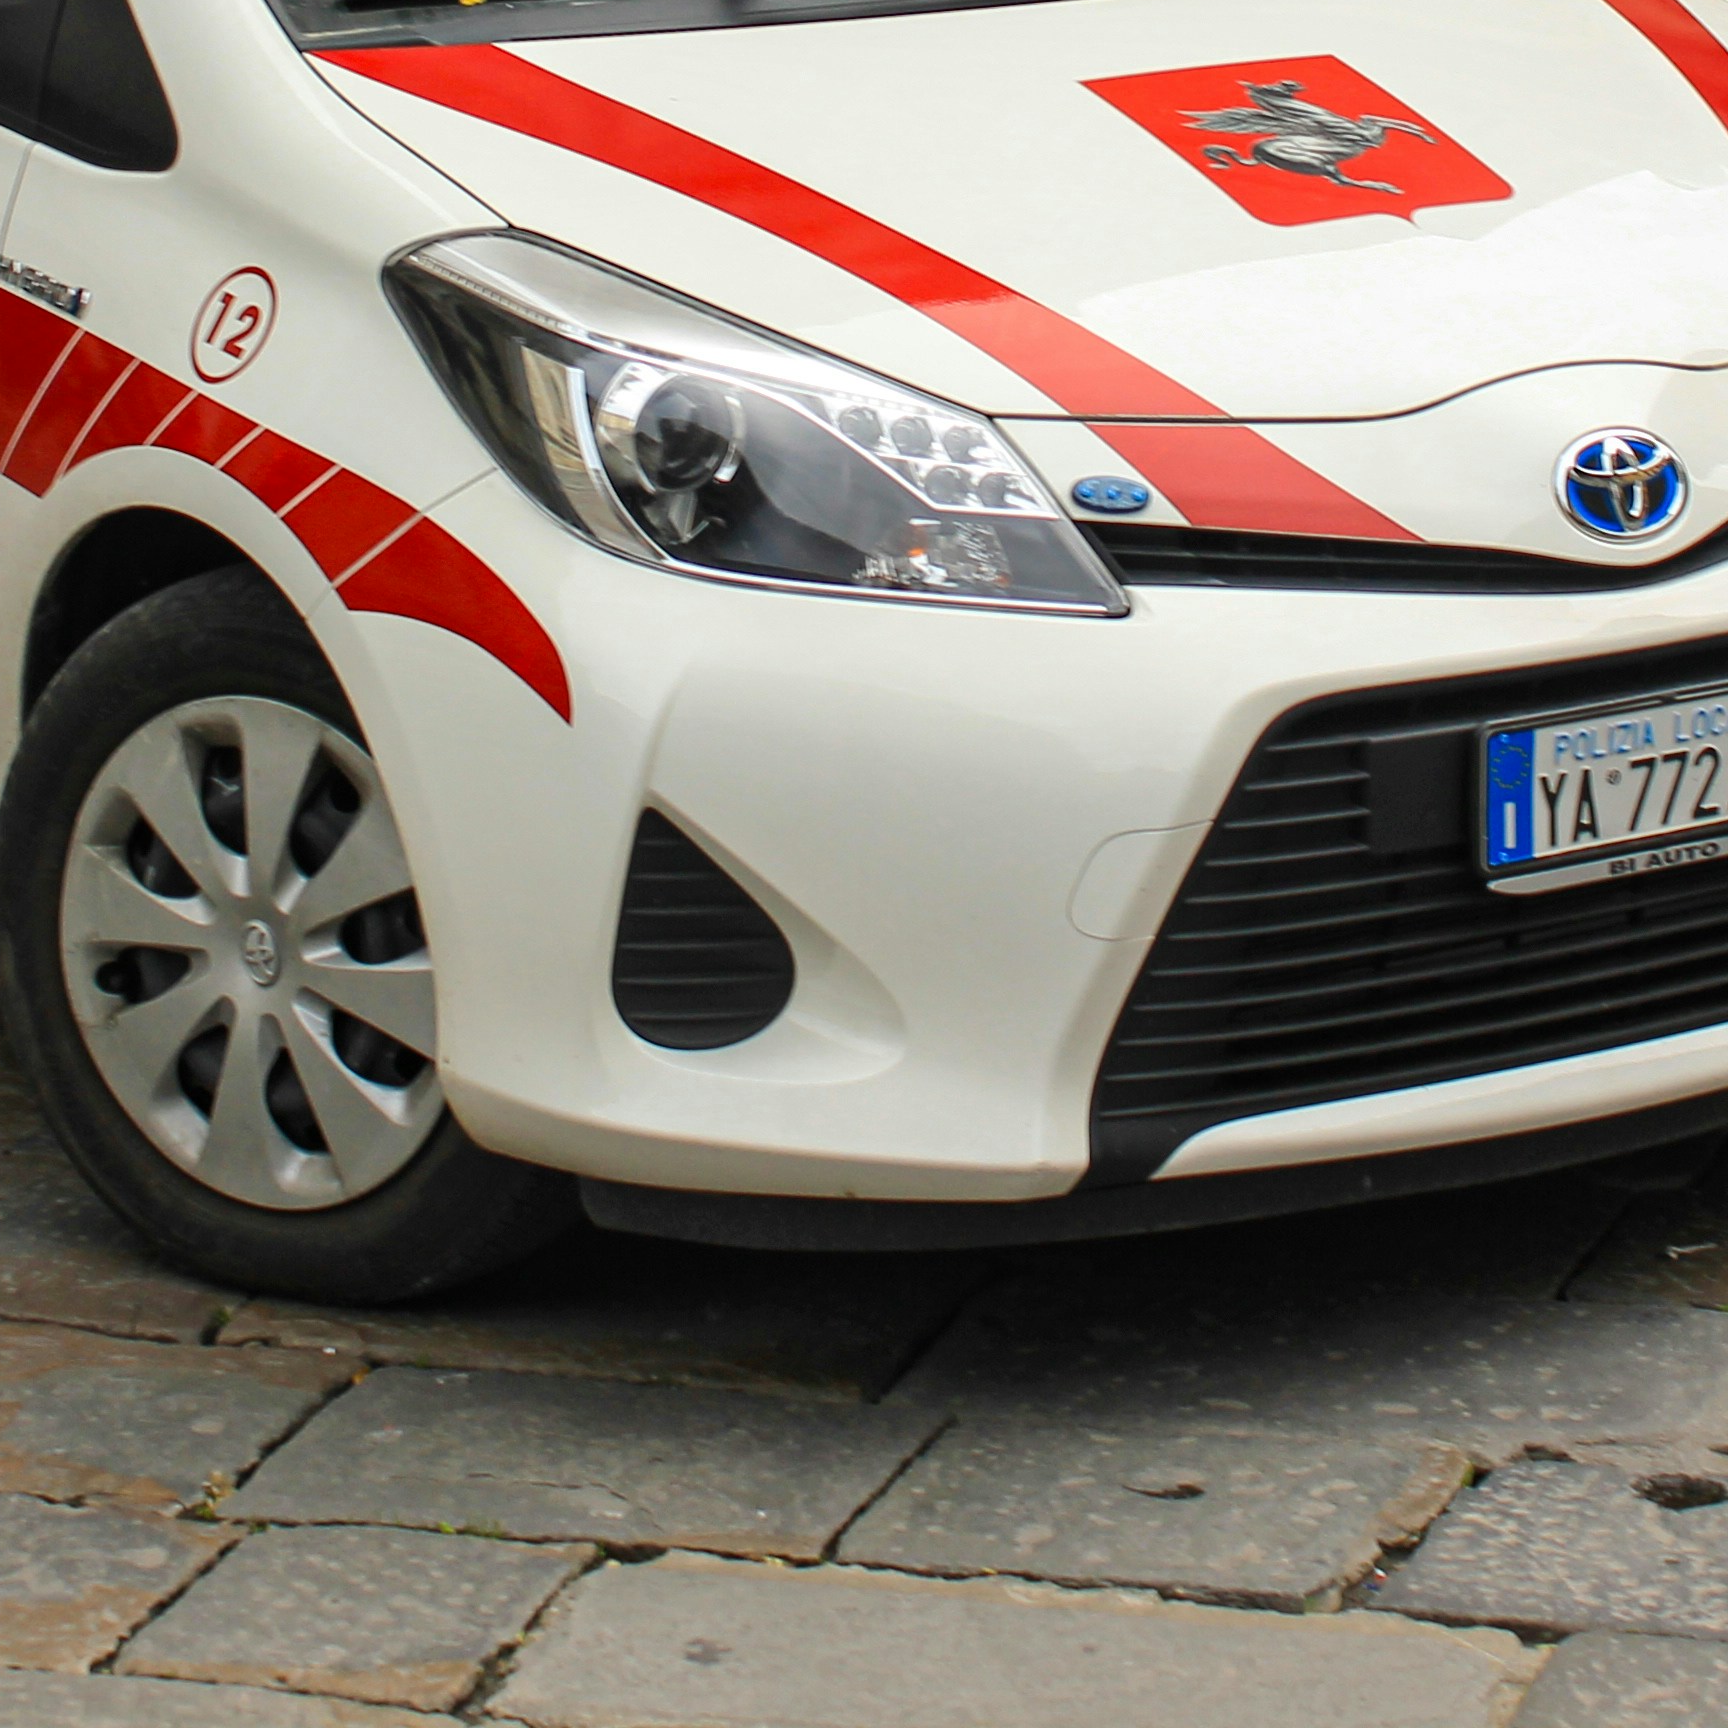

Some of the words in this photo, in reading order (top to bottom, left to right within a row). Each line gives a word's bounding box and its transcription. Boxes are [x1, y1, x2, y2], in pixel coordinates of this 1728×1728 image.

[205, 291, 262, 359] 12
[1554, 718, 1656, 763] POLIZIA
[1646, 841, 1721, 869] AUTO
